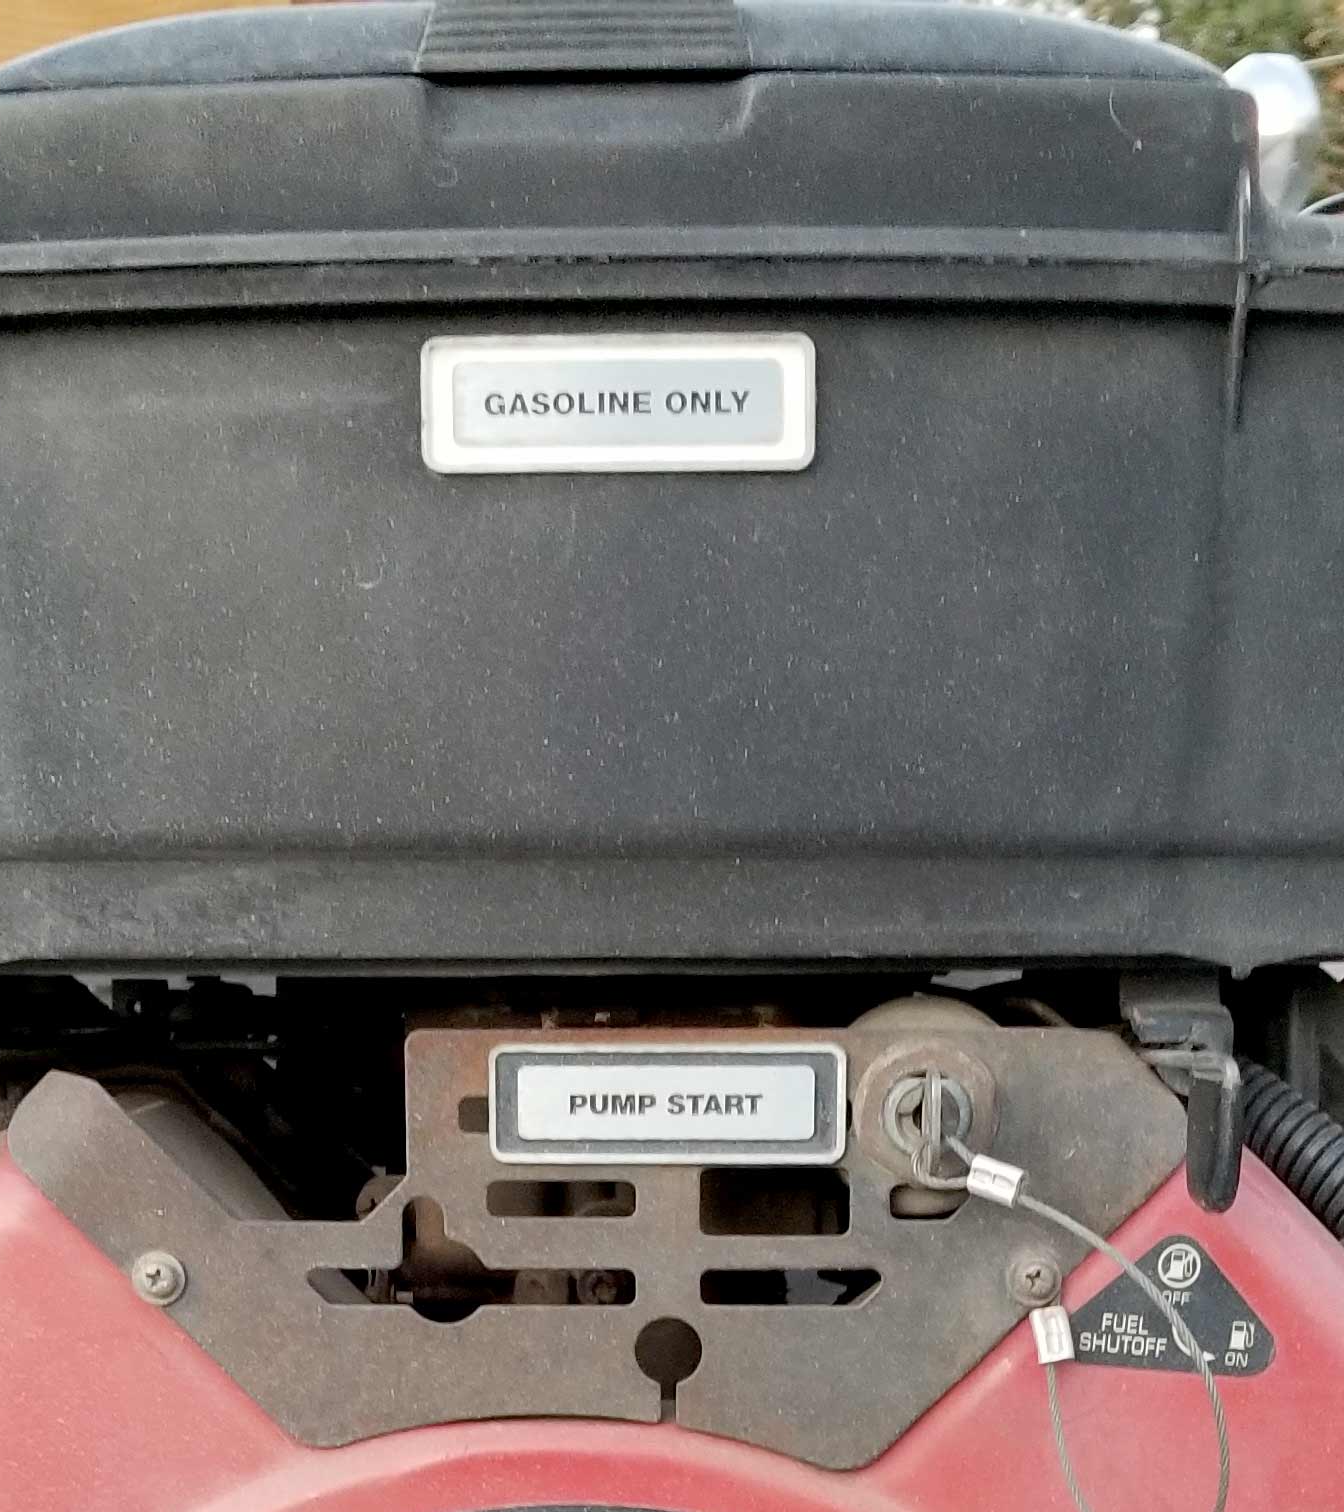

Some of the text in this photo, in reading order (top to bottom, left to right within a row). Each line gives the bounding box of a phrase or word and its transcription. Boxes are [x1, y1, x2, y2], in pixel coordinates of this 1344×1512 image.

[484, 390, 750, 416] GASOLINE ONLY
[568, 1092, 764, 1117] PUMP START
[1161, 1290, 1193, 1306] OFF
[1101, 1312, 1149, 1336] FUEL
[1079, 1331, 1168, 1358] SHUTOFF
[1224, 1351, 1249, 1368] ON
